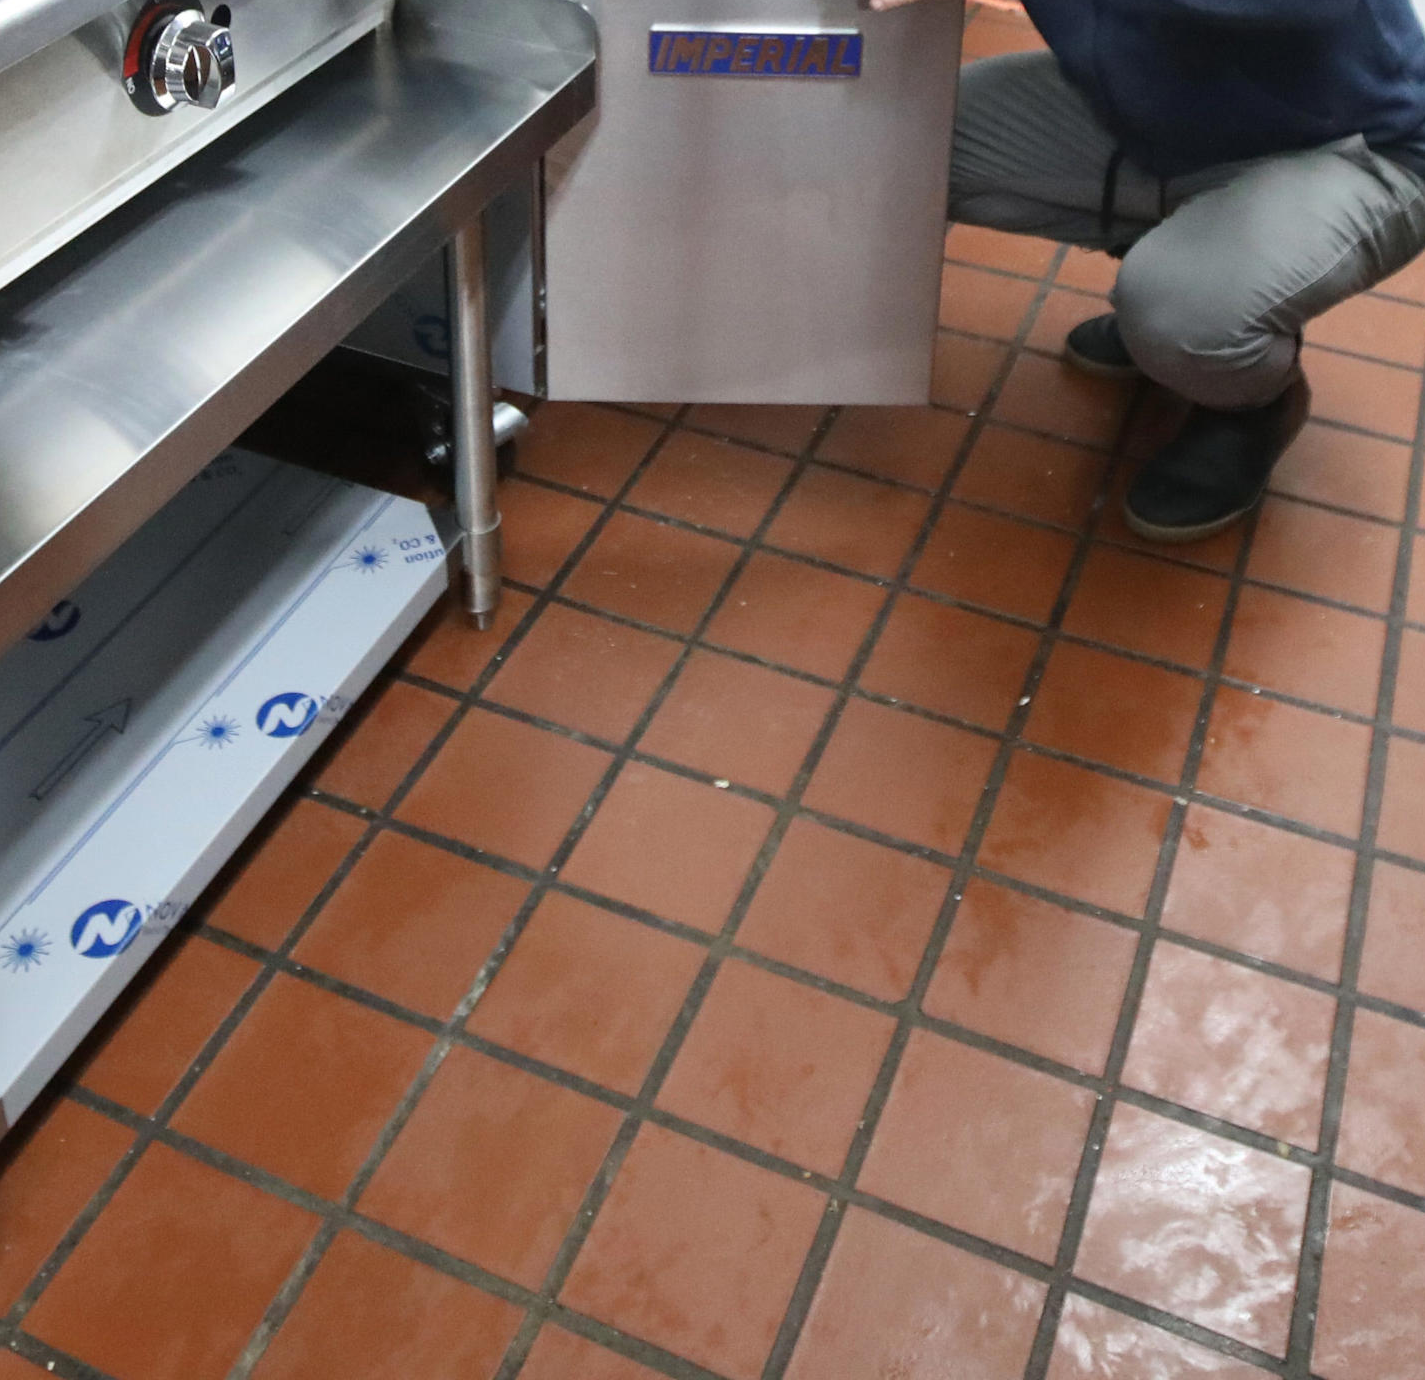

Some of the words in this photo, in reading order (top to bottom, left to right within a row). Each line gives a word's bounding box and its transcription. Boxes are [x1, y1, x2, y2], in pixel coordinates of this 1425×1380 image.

[654, 34, 857, 73] IMPERIAL
[424, 534, 437, 545] &
[405, 548, 445, 564] ution
